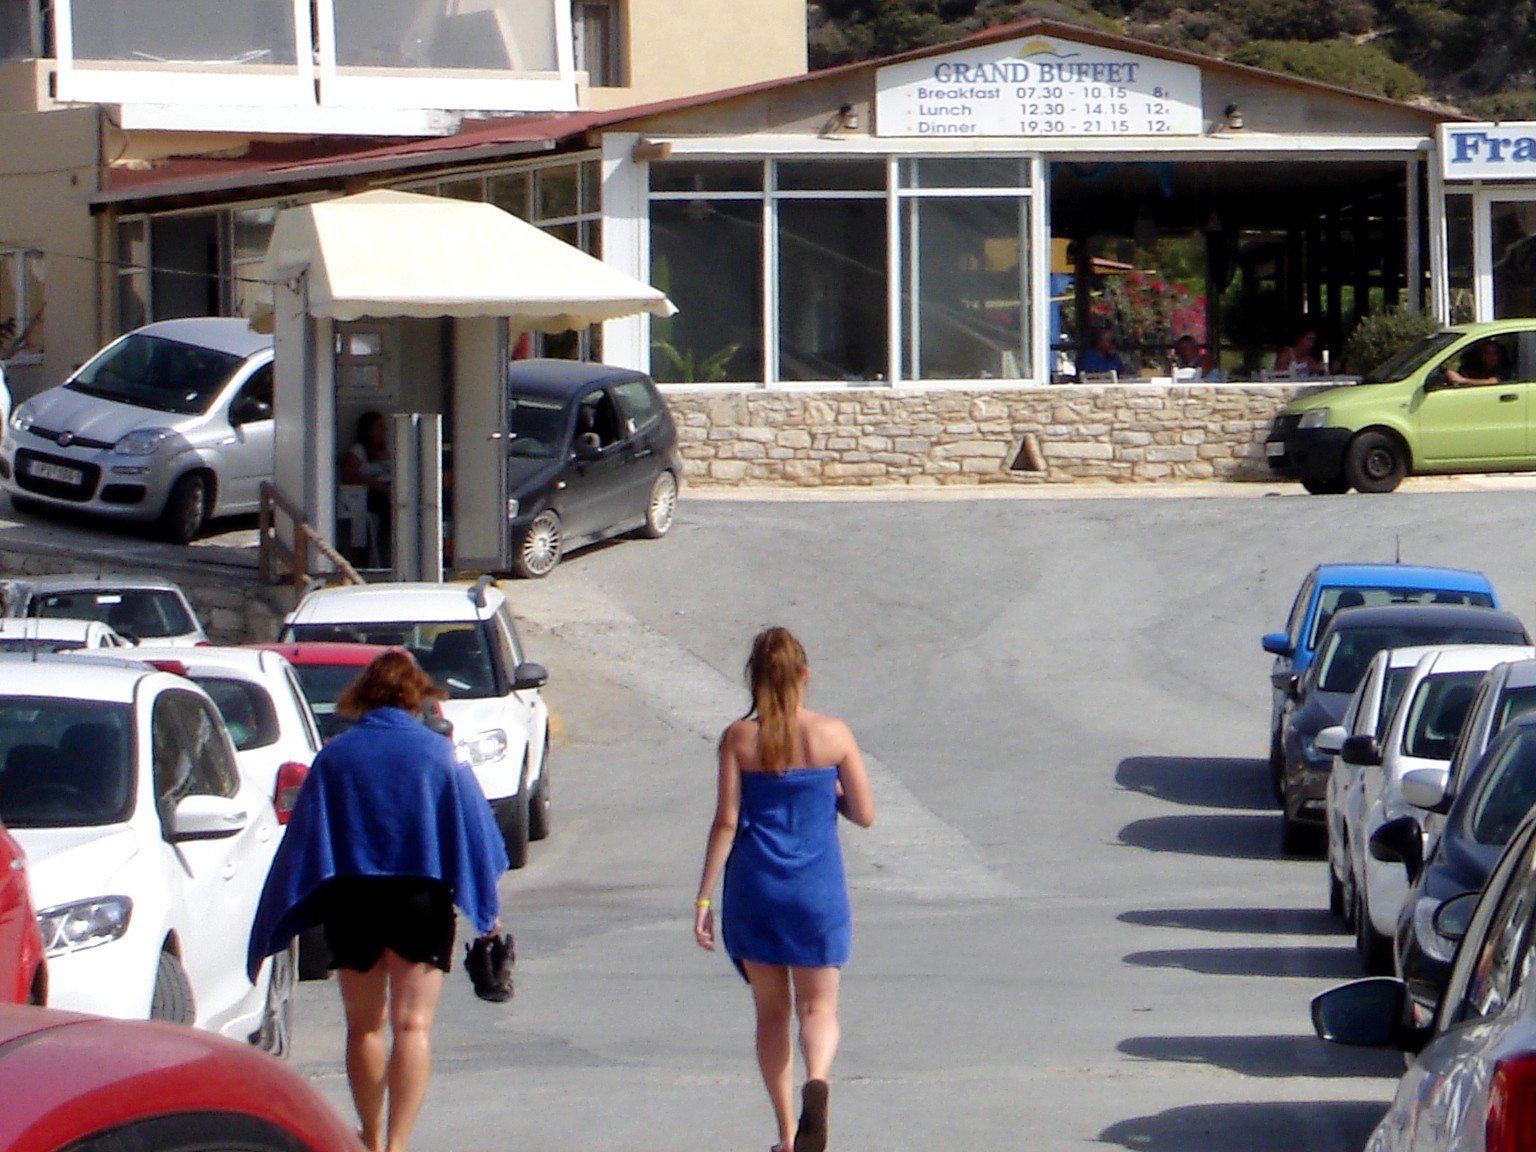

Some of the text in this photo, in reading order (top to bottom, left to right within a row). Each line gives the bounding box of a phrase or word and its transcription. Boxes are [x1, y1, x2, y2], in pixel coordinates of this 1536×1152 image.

[934, 62, 1140, 84] GRAND BUFFET
[918, 87, 1001, 100] Breakfast
[1016, 86, 1063, 99] 07.30
[1084, 86, 1128, 99] 10.15
[920, 104, 973, 116] Lunch
[1020, 103, 1065, 116] 12.30
[1085, 103, 1128, 115] 14.15
[919, 121, 976, 133] Dinner
[1020, 120, 1065, 133] 19.30
[1083, 120, 1129, 133] 21.15
